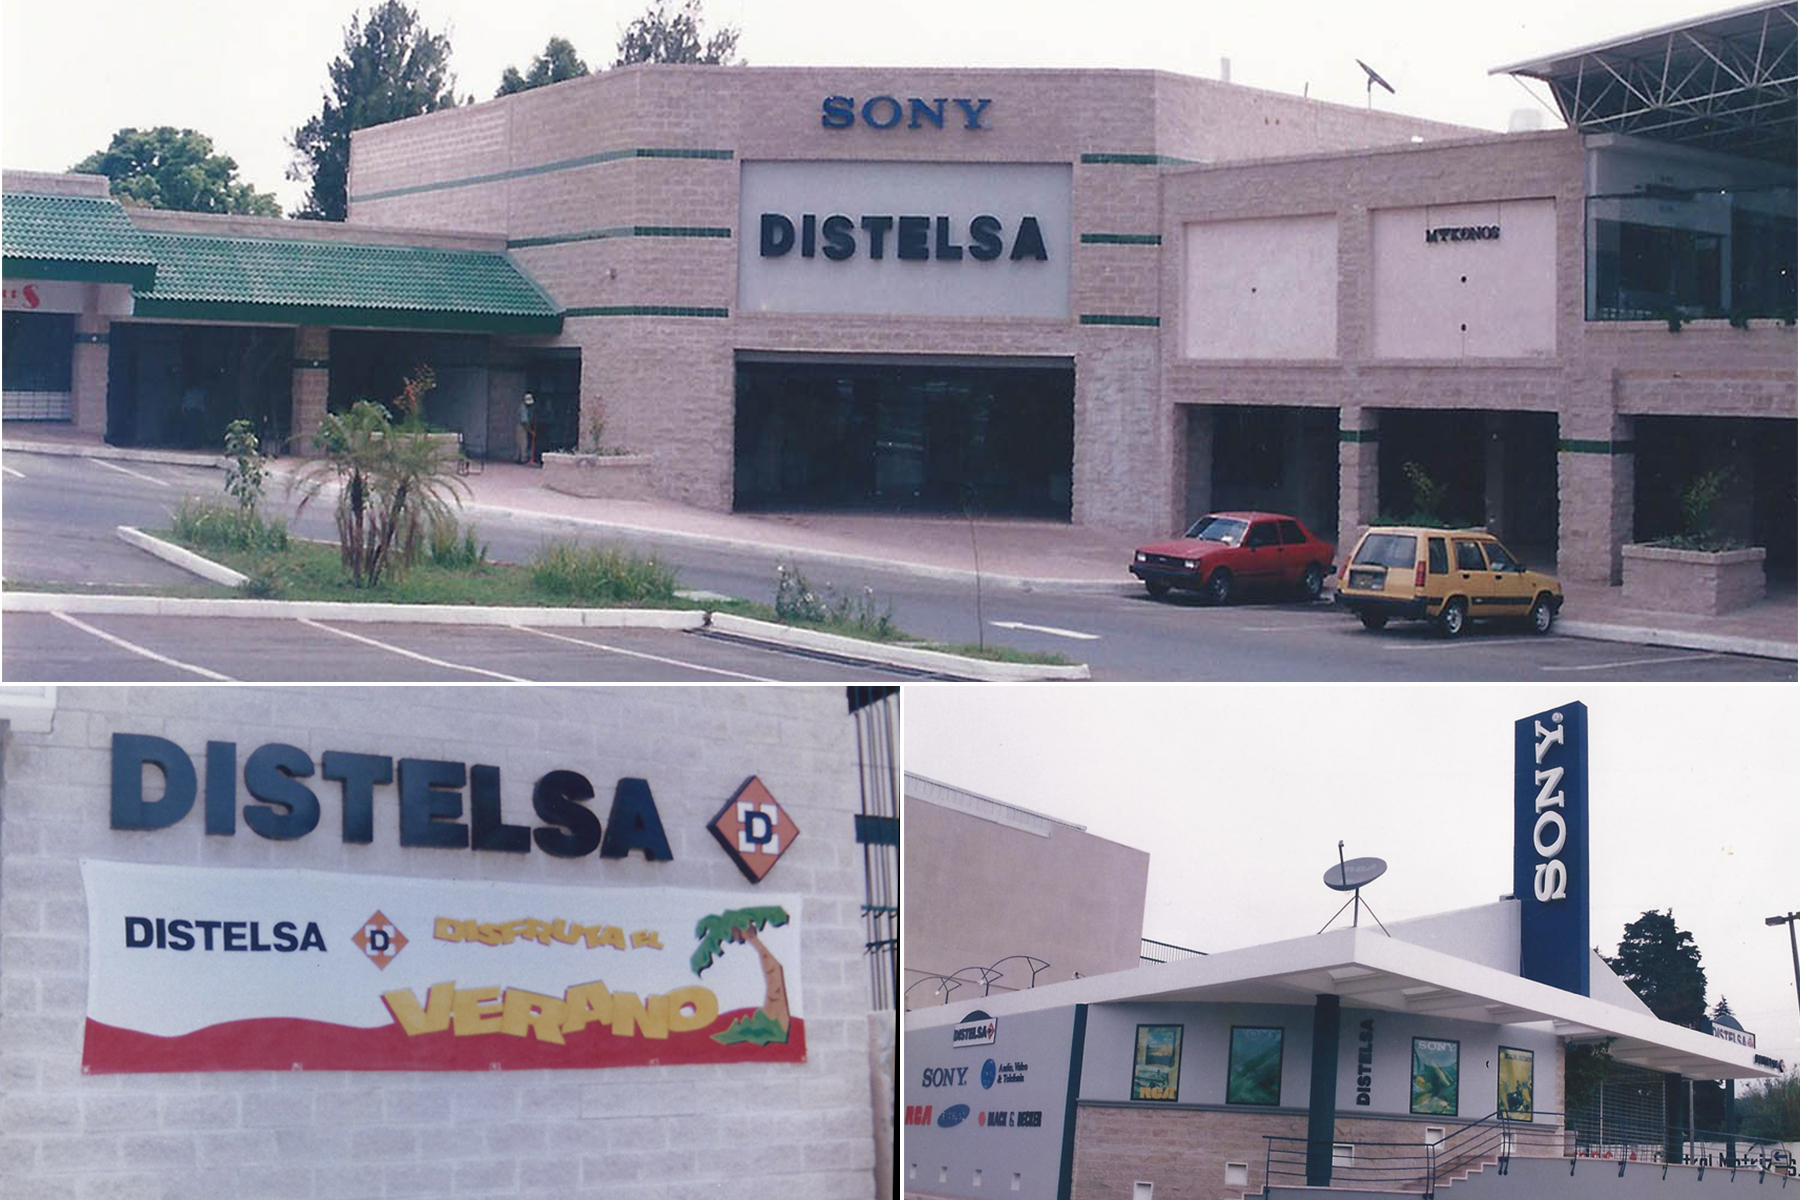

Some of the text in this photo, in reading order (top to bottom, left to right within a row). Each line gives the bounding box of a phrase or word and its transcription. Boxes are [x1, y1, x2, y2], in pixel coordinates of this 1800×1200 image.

[822, 95, 992, 129] SONY
[760, 213, 1048, 261] DISTELSA
[1426, 225, 1500, 242] MYKONOS
[110, 732, 674, 862] DISTELSA
[1533, 719, 1568, 903] SONY
[745, 810, 772, 844] D
[124, 917, 327, 953] DISTELSA
[370, 930, 389, 951] D
[433, 916, 664, 951] DISFRUTA EL
[380, 980, 719, 1045] VERANO
[953, 1026, 987, 1041] DISTELSA
[1418, 1041, 1456, 1052] SONY
[1356, 1019, 1374, 1106] DISTELSA
[1139, 1086, 1175, 1099] RCA
[904, 1105, 932, 1126] RCA
[987, 1111, 1008, 1127] BLACK
[1016, 1111, 1042, 1127] DECKER
